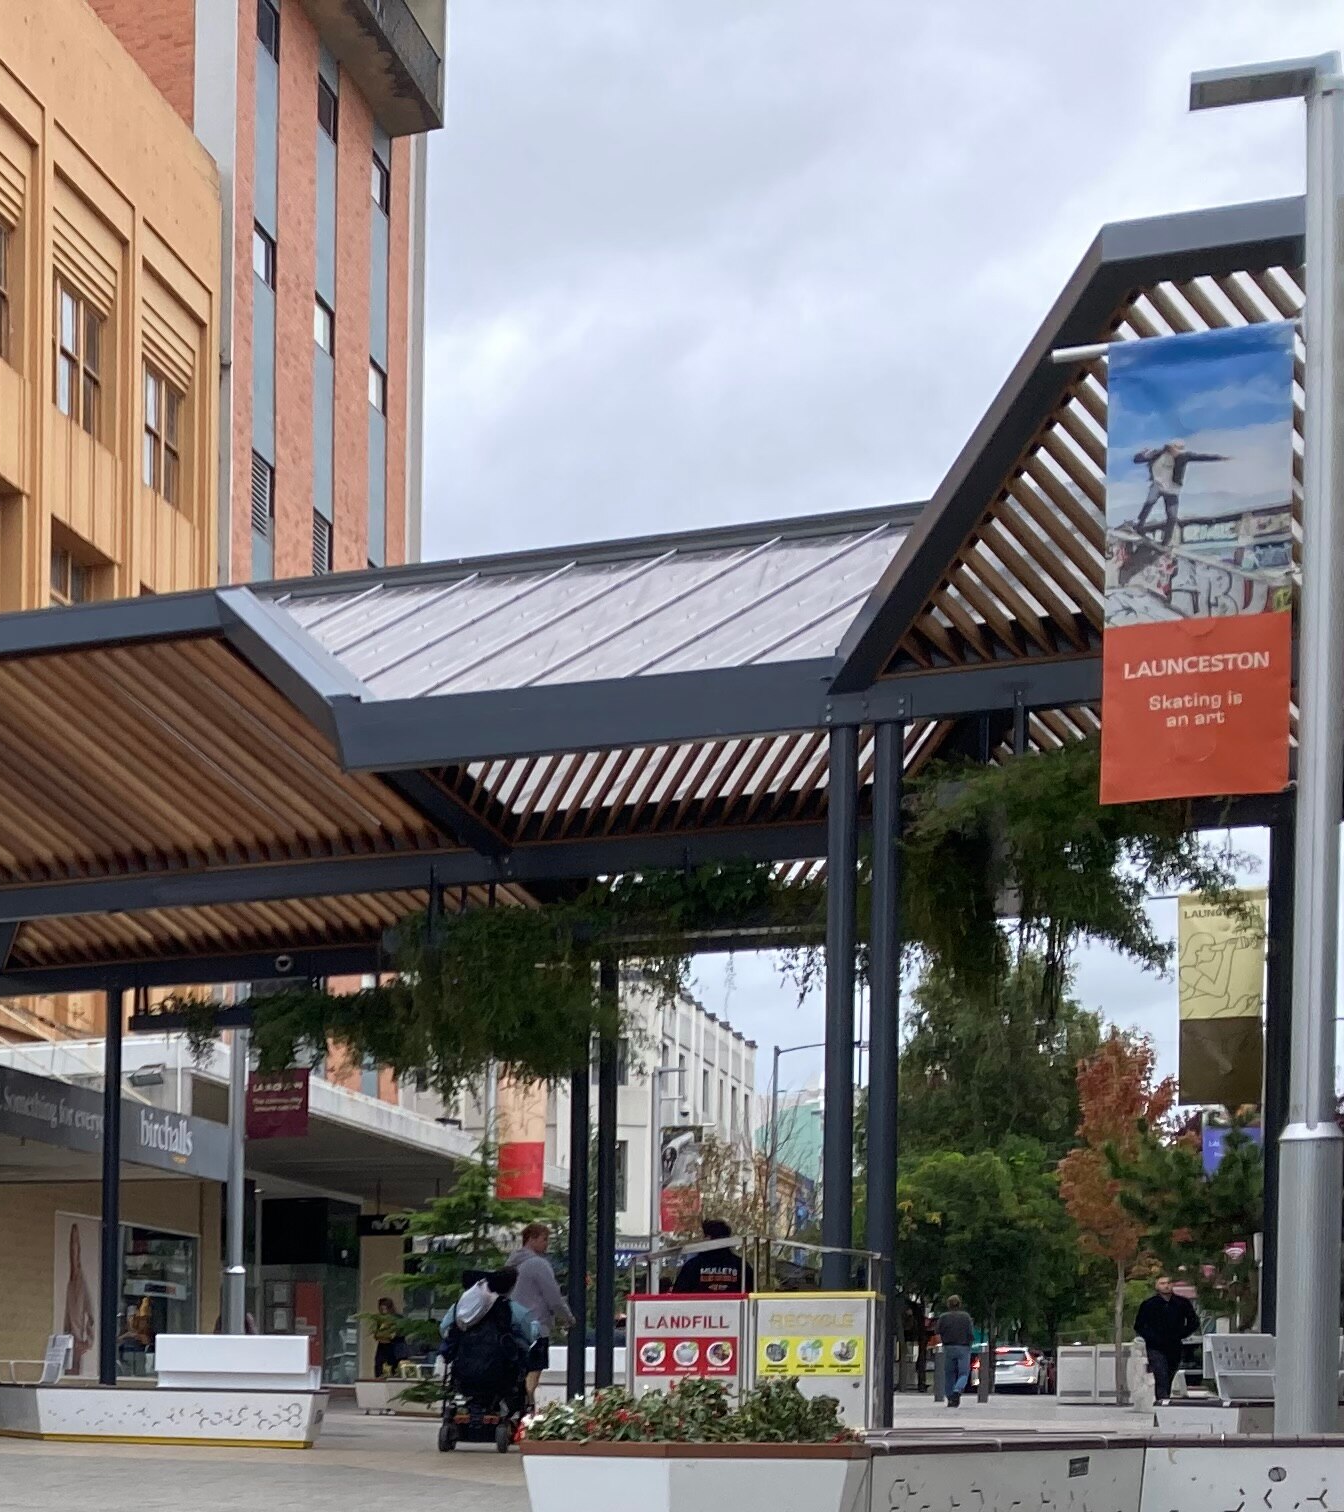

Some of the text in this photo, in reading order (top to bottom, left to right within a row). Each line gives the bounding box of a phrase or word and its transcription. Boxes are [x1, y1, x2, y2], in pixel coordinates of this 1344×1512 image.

[1124, 651, 1270, 680] LAUNCESTON
[1149, 689, 1243, 711] Skating is
[1166, 711, 1225, 728] an art
[141, 1108, 193, 1157] birchalls
[644, 1315, 730, 1329] LANDFILL
[769, 1312, 856, 1328] RECYCLE
